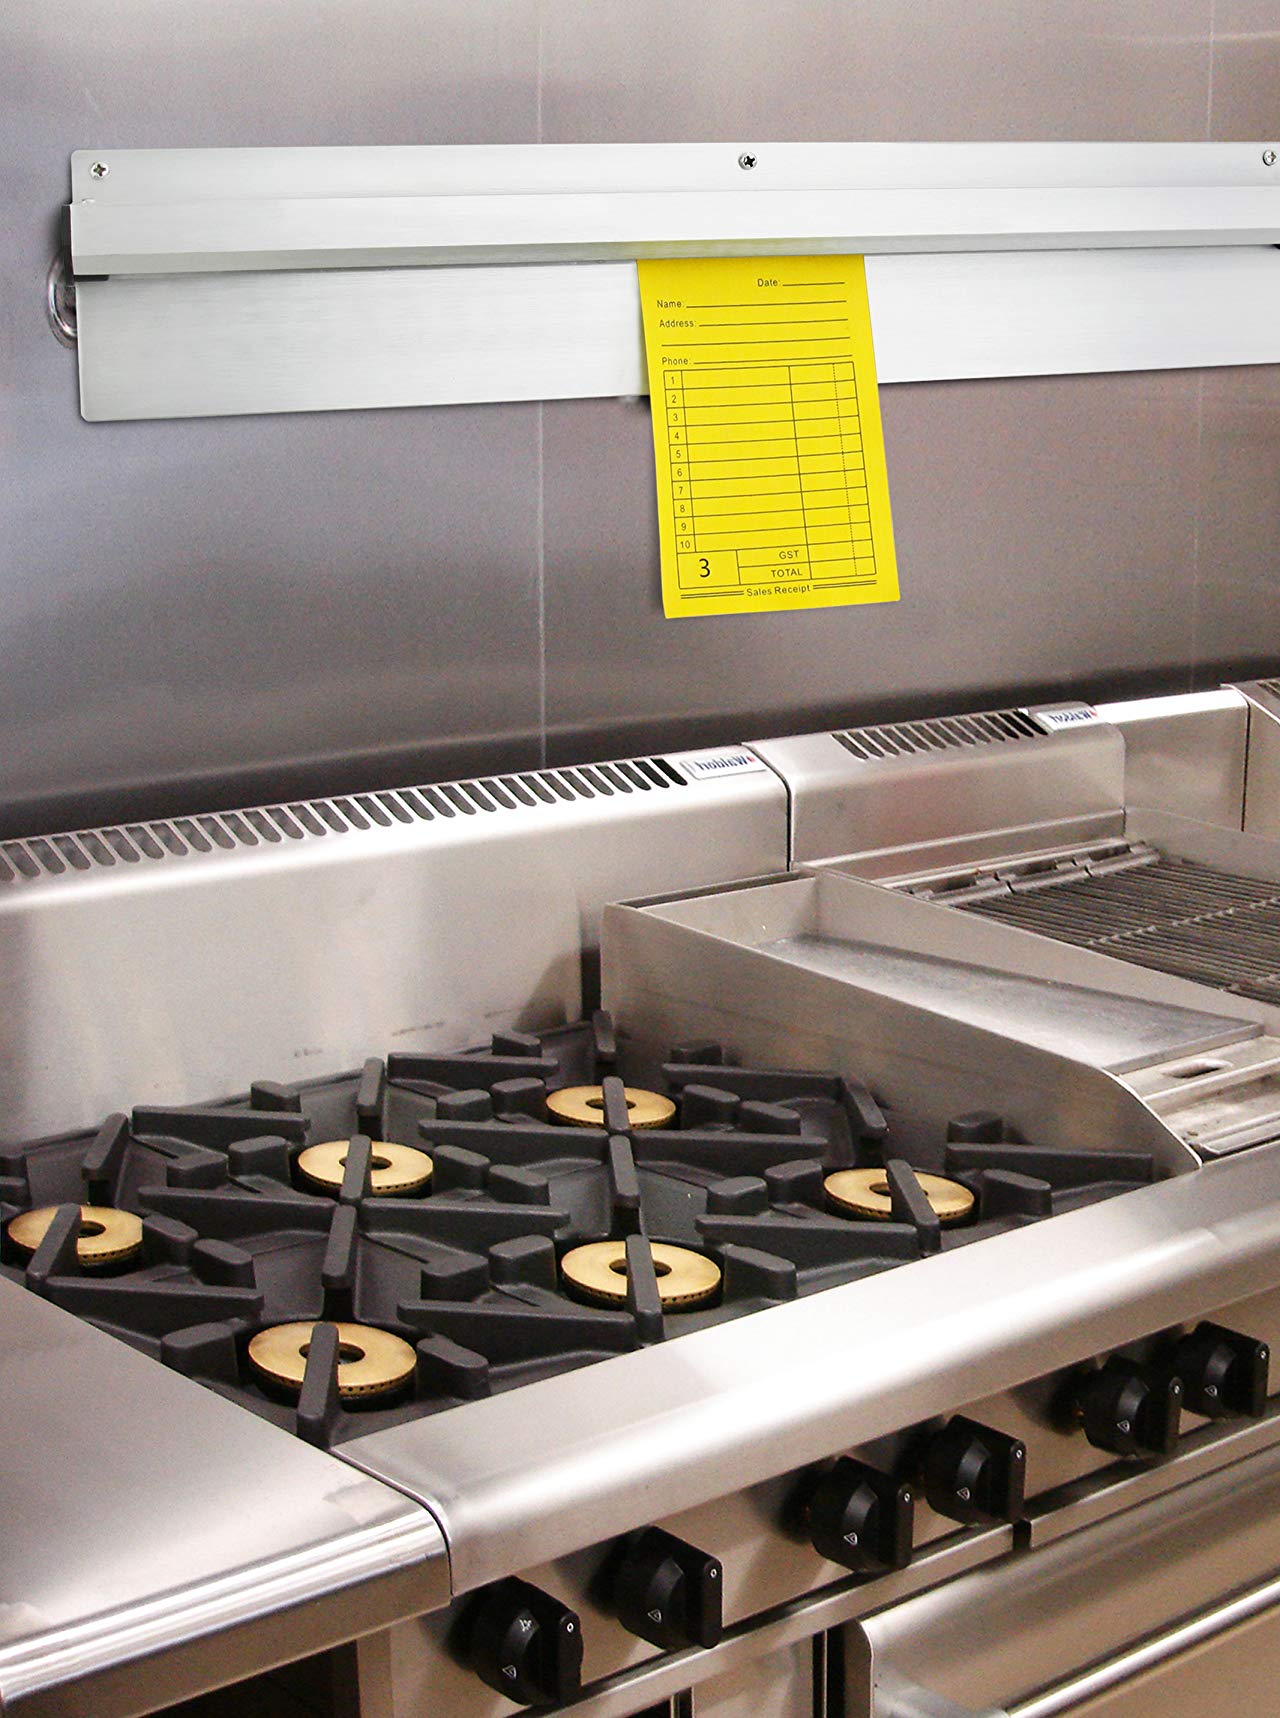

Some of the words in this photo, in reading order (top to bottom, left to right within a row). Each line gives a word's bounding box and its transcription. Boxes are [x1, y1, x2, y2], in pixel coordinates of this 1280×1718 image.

[670, 376, 676, 385] 1
[671, 394, 677, 404] 2
[673, 412, 679, 422] 3
[674, 432, 680, 441] 4
[676, 450, 681, 459] 5
[677, 468, 683, 477] 6
[678, 486, 684, 496] 7
[679, 504, 685, 514] 8
[681, 522, 687, 532] 9
[680, 540, 691, 550] 10
[779, 550, 800, 560] GST
[699, 558, 711, 578] 3
[771, 569, 803, 579] TOTAL
[746, 587, 772, 598] Sales
[774, 584, 811, 596] Receipt
